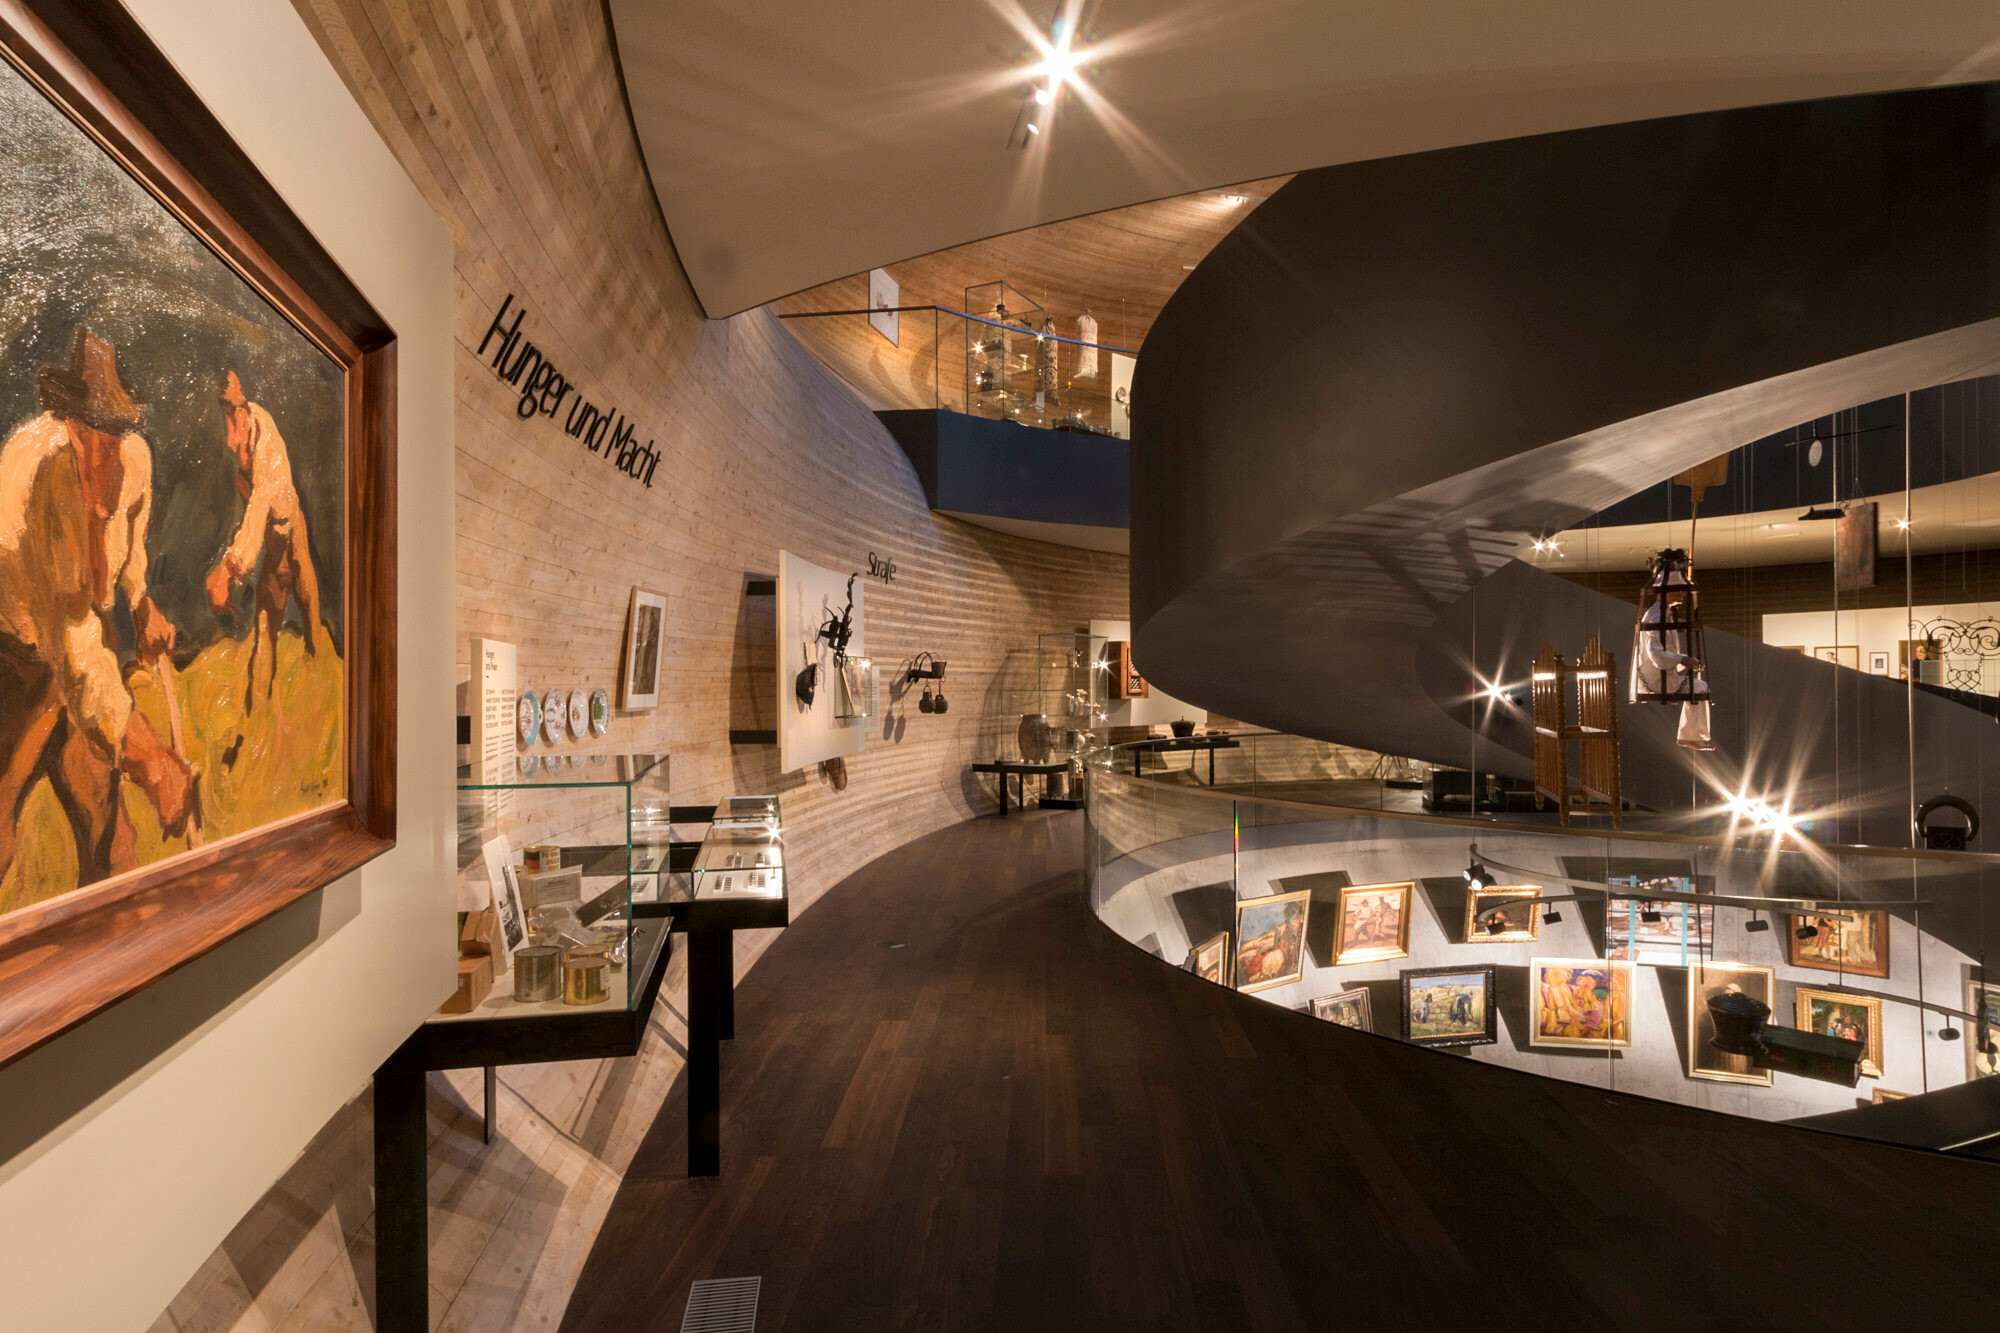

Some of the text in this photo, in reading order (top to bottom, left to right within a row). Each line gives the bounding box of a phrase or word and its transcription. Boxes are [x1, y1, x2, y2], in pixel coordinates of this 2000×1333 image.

[477, 293, 661, 488] Hunger und Macht
[866, 551, 897, 584] Strafe
